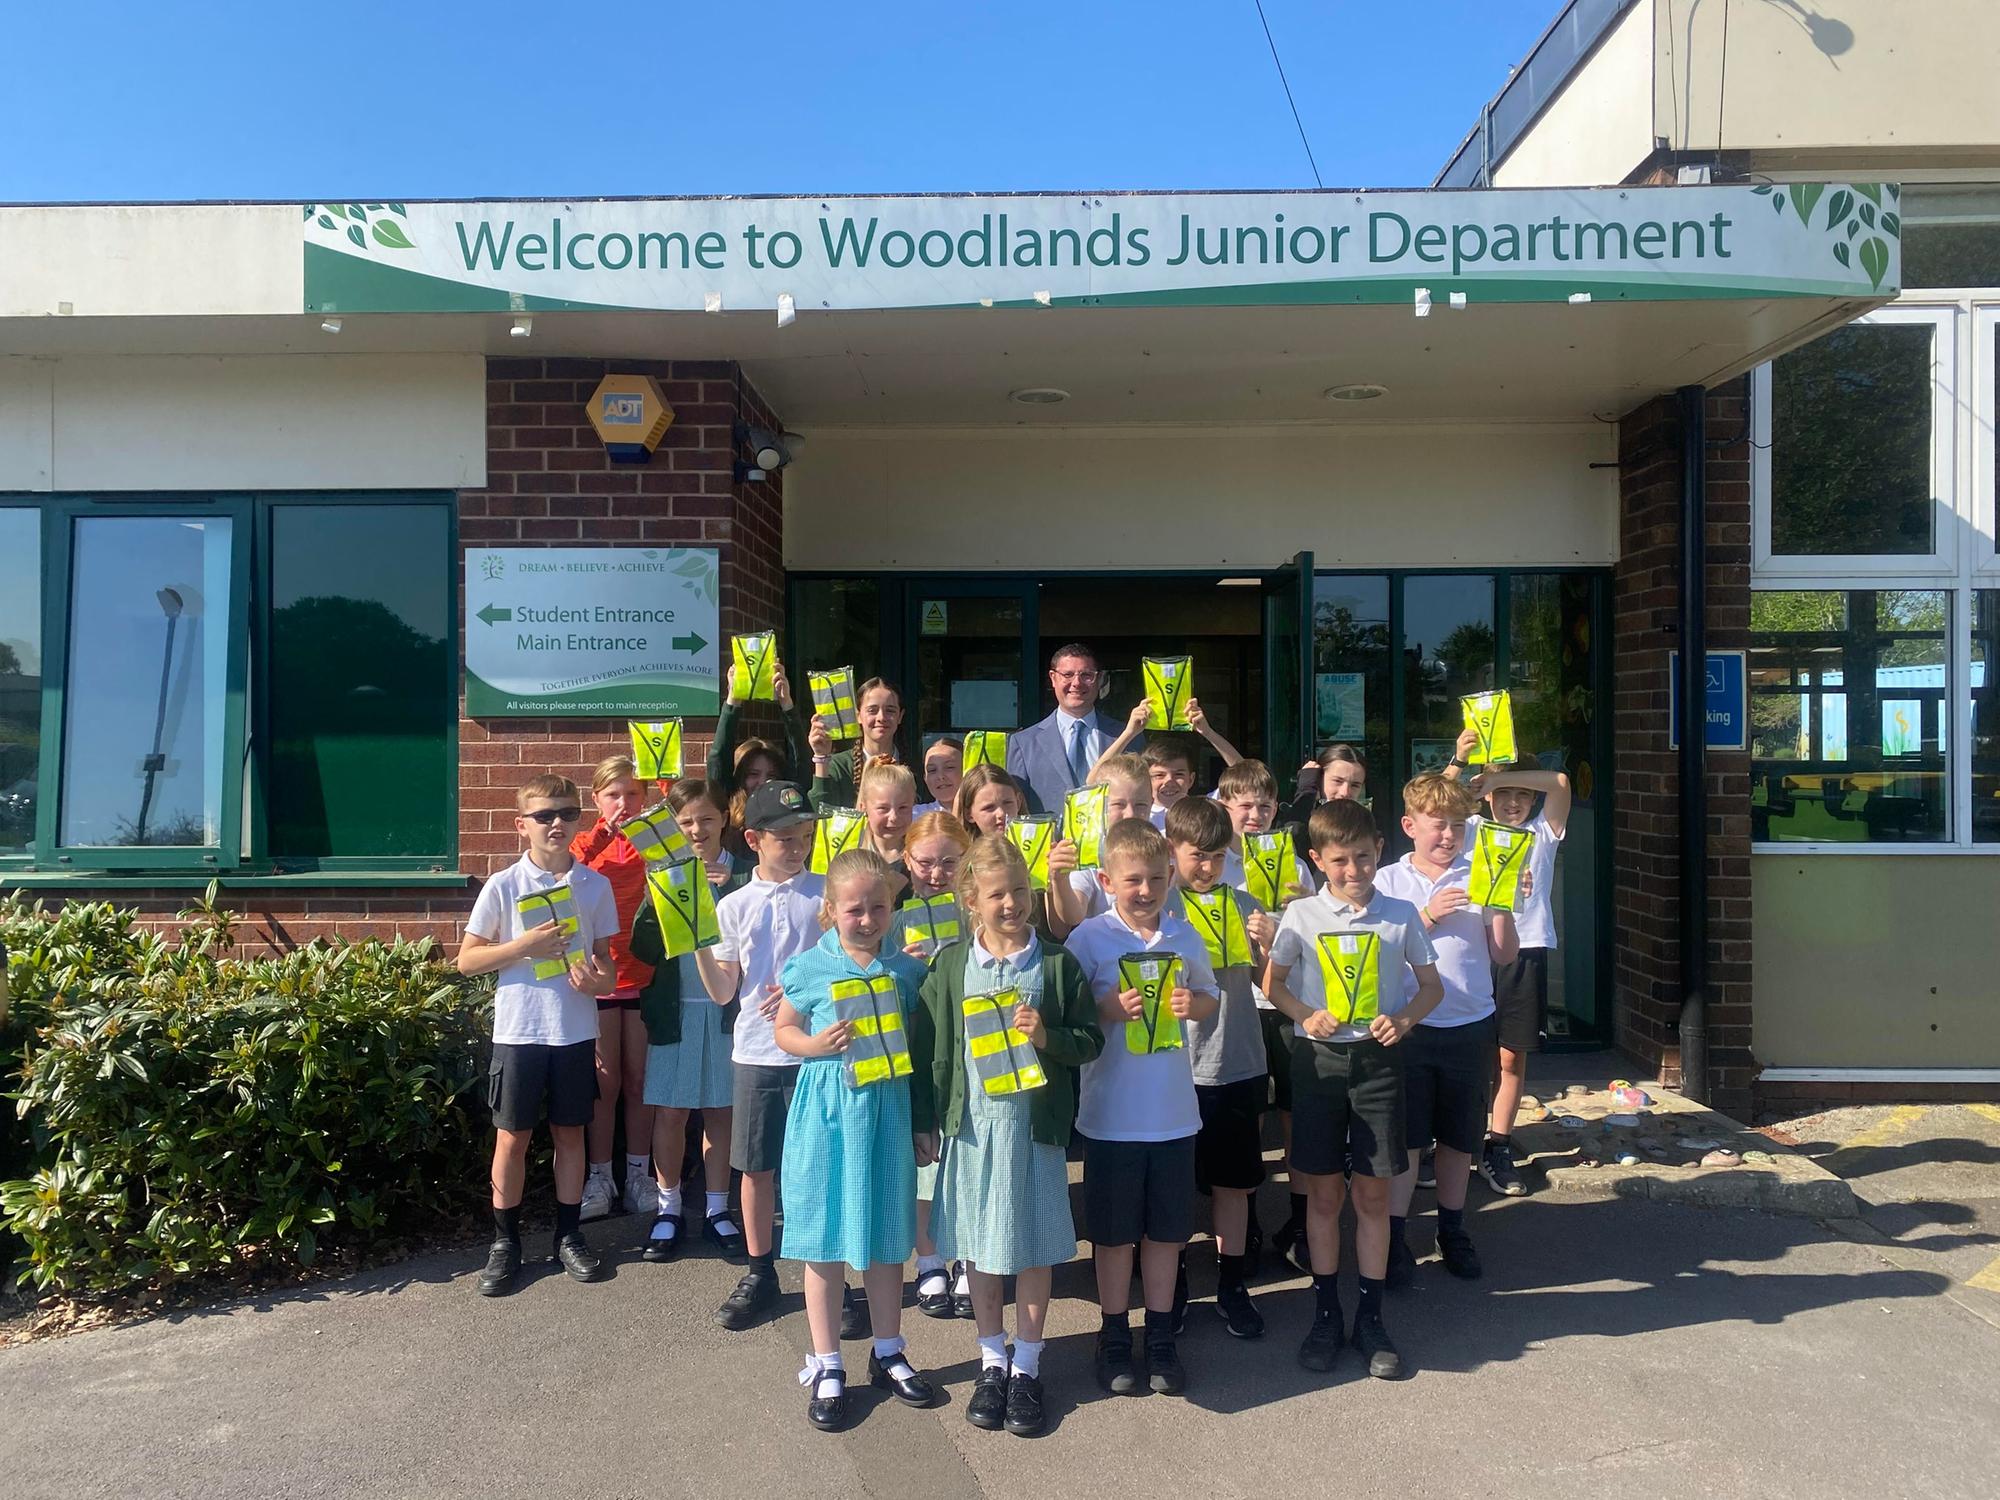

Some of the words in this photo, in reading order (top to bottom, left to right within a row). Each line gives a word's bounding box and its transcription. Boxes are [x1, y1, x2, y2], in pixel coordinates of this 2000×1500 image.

[455, 218, 727, 271] Welcome
[742, 223, 803, 269] to
[818, 212, 1151, 269] Woodlands
[1166, 212, 1351, 266] Junior
[1368, 210, 1733, 277] Department
[604, 399, 642, 417] ADT
[519, 563, 558, 573] DREAM
[567, 563, 609, 573] BELIEVE
[617, 563, 665, 573] ACHIEVE
[517, 606, 590, 623] Student
[595, 608, 675, 623] Entrance
[517, 634, 561, 651] Main
[567, 634, 647, 651] Entrance
[745, 655, 755, 666] S
[541, 675, 591, 692] TOGETHER
[592, 665, 636, 682] EVERYONE
[639, 663, 684, 672] ACHIEVES
[686, 665, 713, 675] MORE
[1165, 683, 1174, 694] S
[506, 701, 518, 710] All
[519, 701, 548, 710] visitors
[549, 701, 577, 712] please
[578, 702, 603, 712] report
[605, 702, 615, 710] to
[615, 701, 637, 710] main
[638, 702, 678, 712] reception
[1481, 717, 1490, 728] S
[1705, 709, 1731, 726] king
[652, 737, 661, 747] S
[831, 836, 841, 849] S
[1023, 839, 1031, 852] S
[1265, 858, 1275, 871] S
[1497, 853, 1507, 865] S
[678, 889, 690, 903] S
[1210, 909, 1221, 921] S
[1344, 965, 1356, 979] S
[1144, 984, 1156, 999] S
